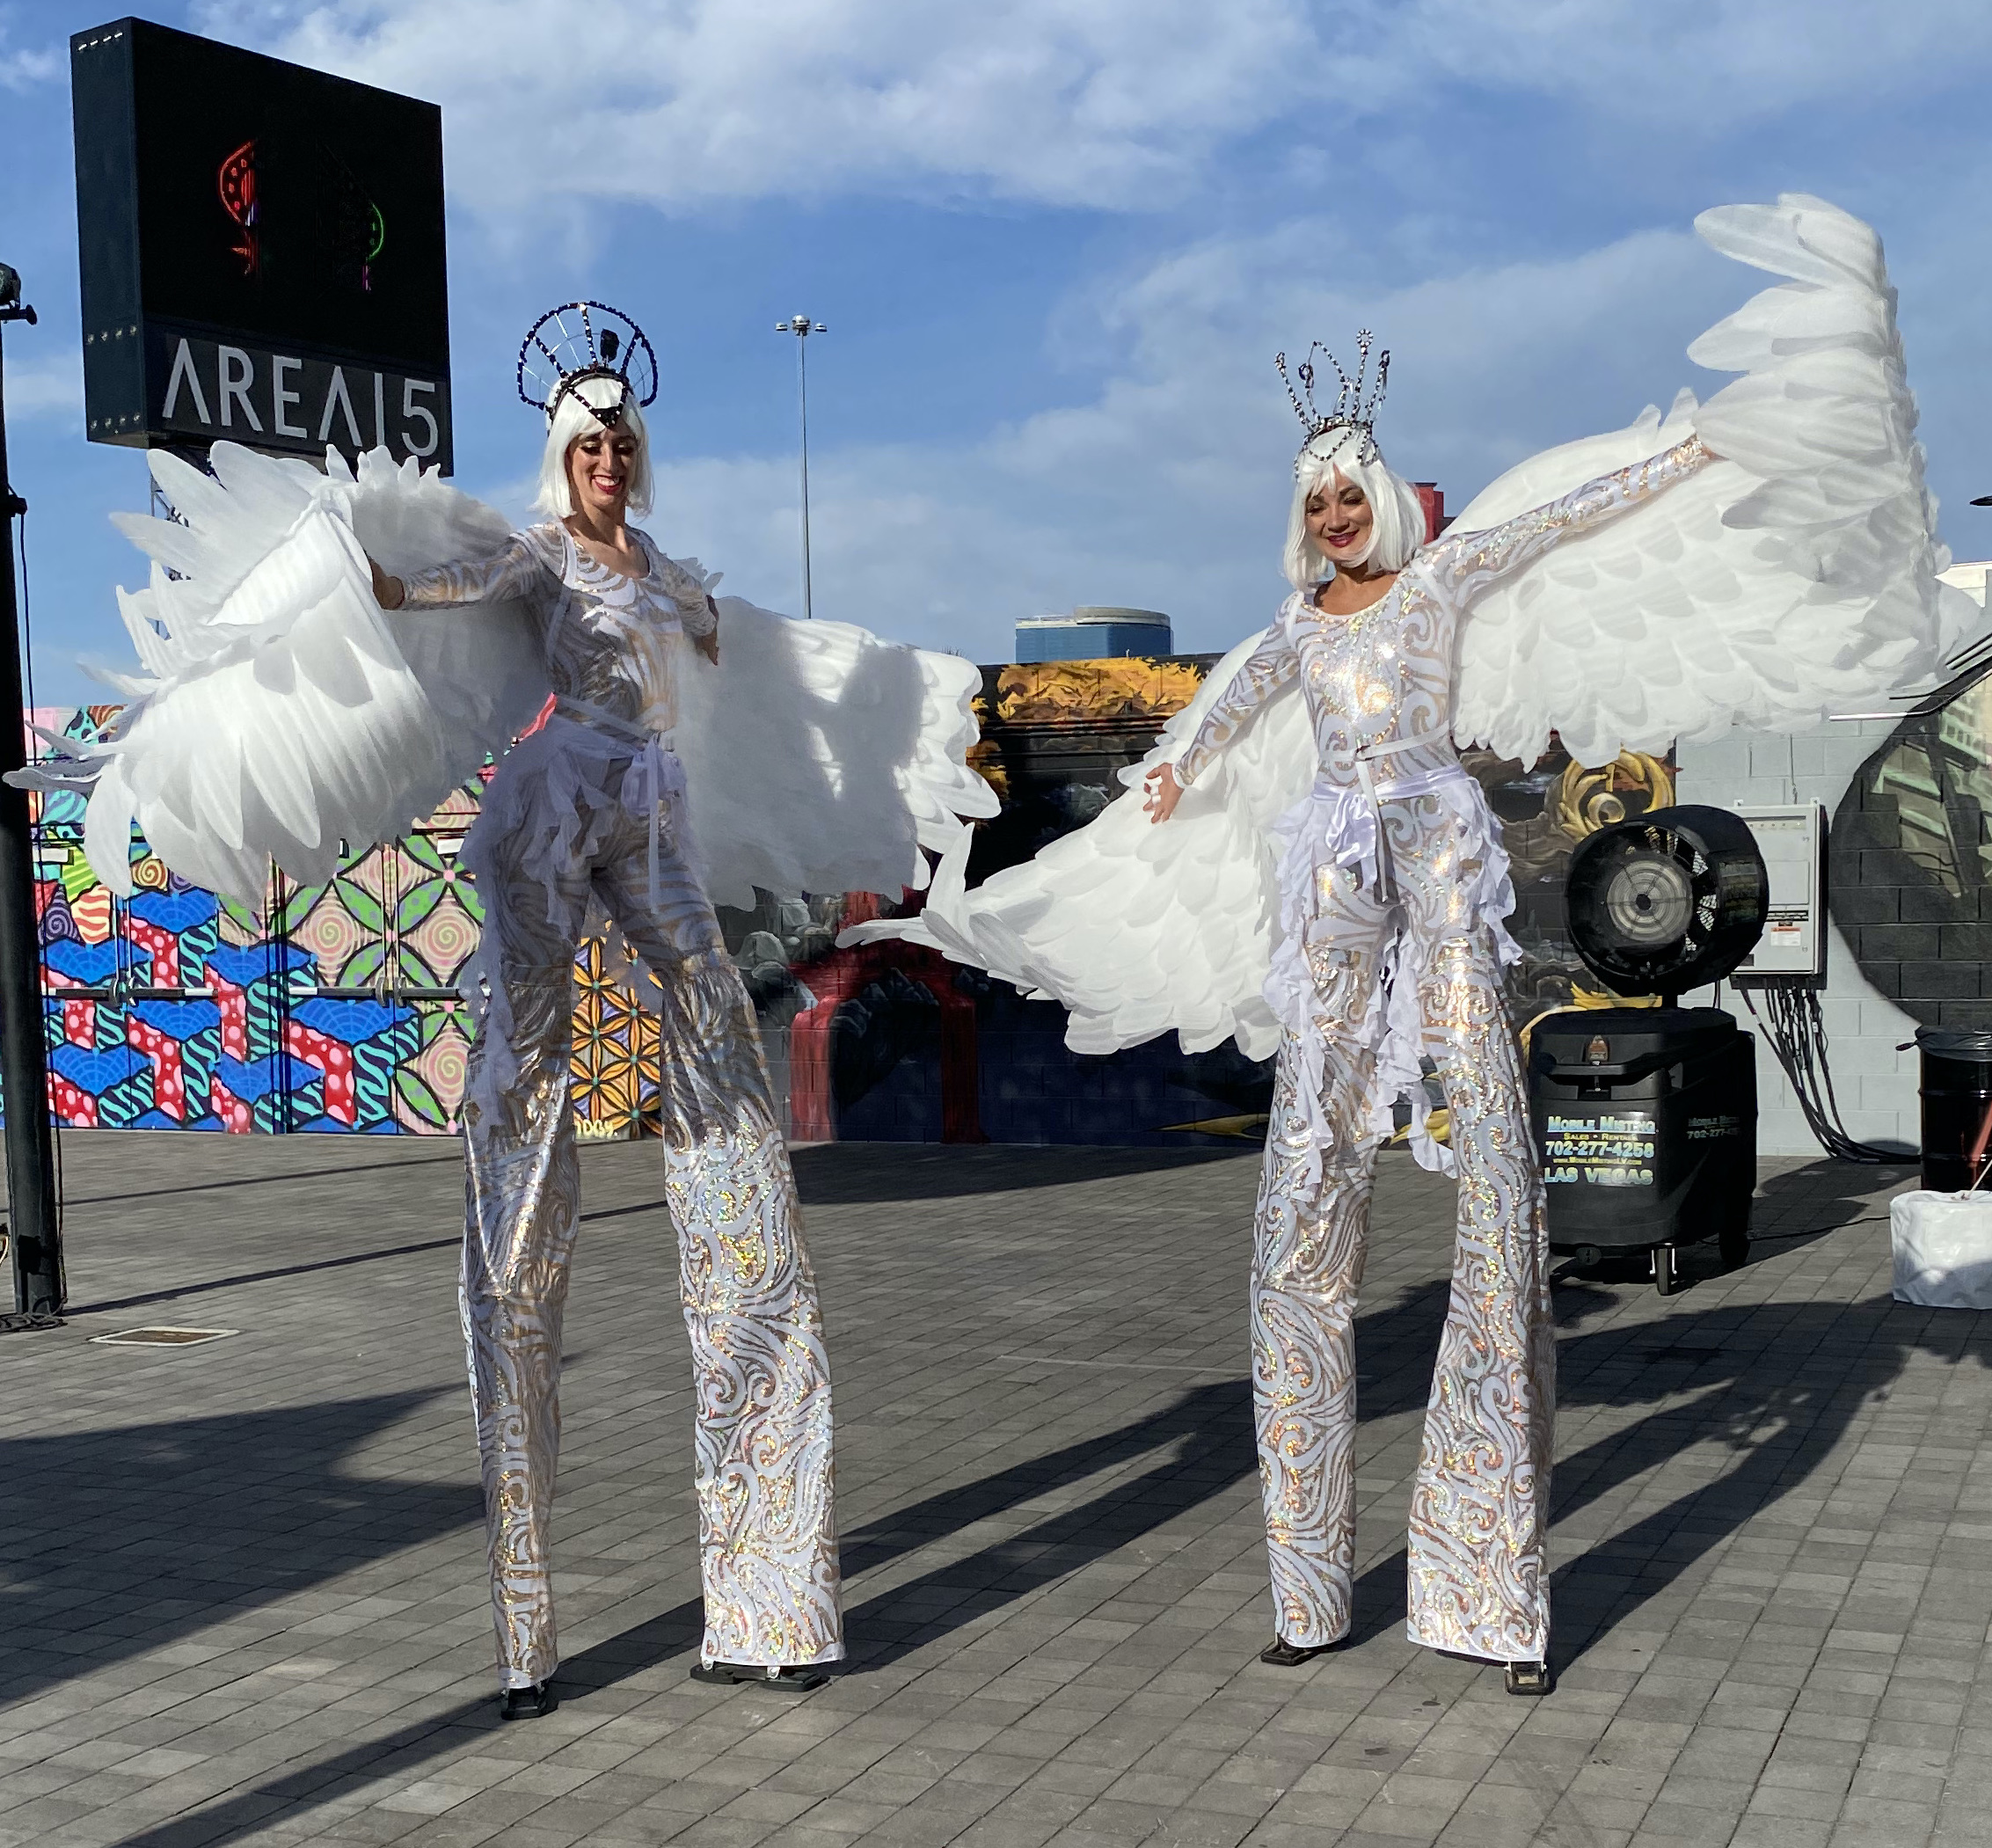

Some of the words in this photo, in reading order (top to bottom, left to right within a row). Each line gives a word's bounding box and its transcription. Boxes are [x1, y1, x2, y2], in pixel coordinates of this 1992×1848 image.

[162, 338, 438, 457] AREA15
[1548, 1115, 1595, 1131] MOBILE
[1545, 1141, 1654, 1158] 702-277-4258
[1544, 1166, 1579, 1183] LAS
[1584, 1167, 1653, 1185] VEGAS
